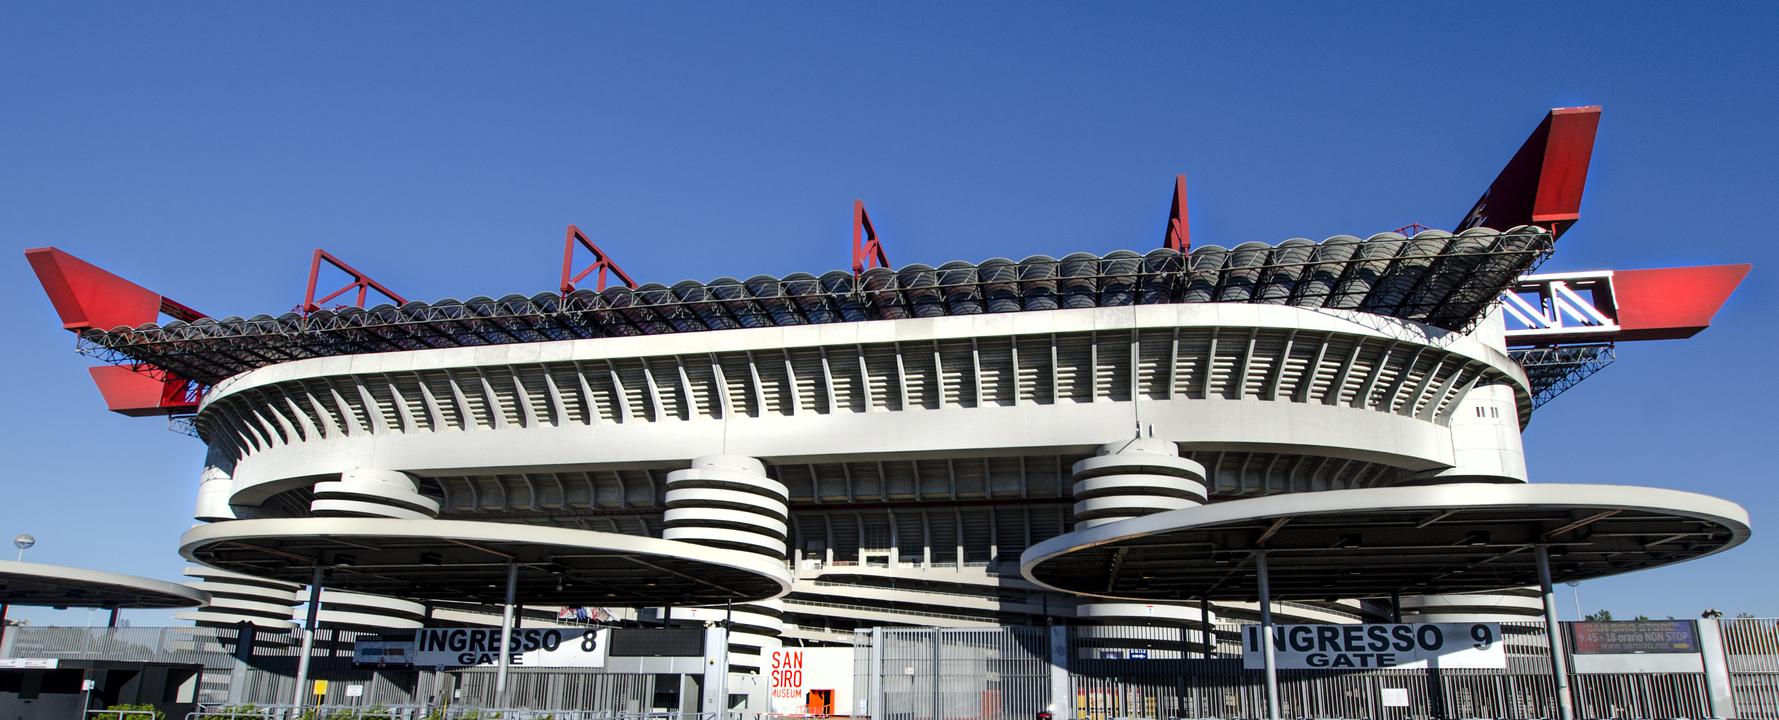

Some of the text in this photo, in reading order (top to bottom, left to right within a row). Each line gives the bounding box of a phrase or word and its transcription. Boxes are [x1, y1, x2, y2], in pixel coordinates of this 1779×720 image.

[419, 629, 597, 652] INGRESSO 8
[1248, 624, 1493, 652] INGRESSO 9
[1606, 633, 1616, 642] 18
[1645, 632, 1664, 641] NON
[1666, 631, 1688, 641] STOP
[771, 651, 803, 669] SAN
[1305, 653, 1397, 667] GATE
[771, 669, 802, 688] SIRO
[772, 688, 802, 698] MUSEUM
